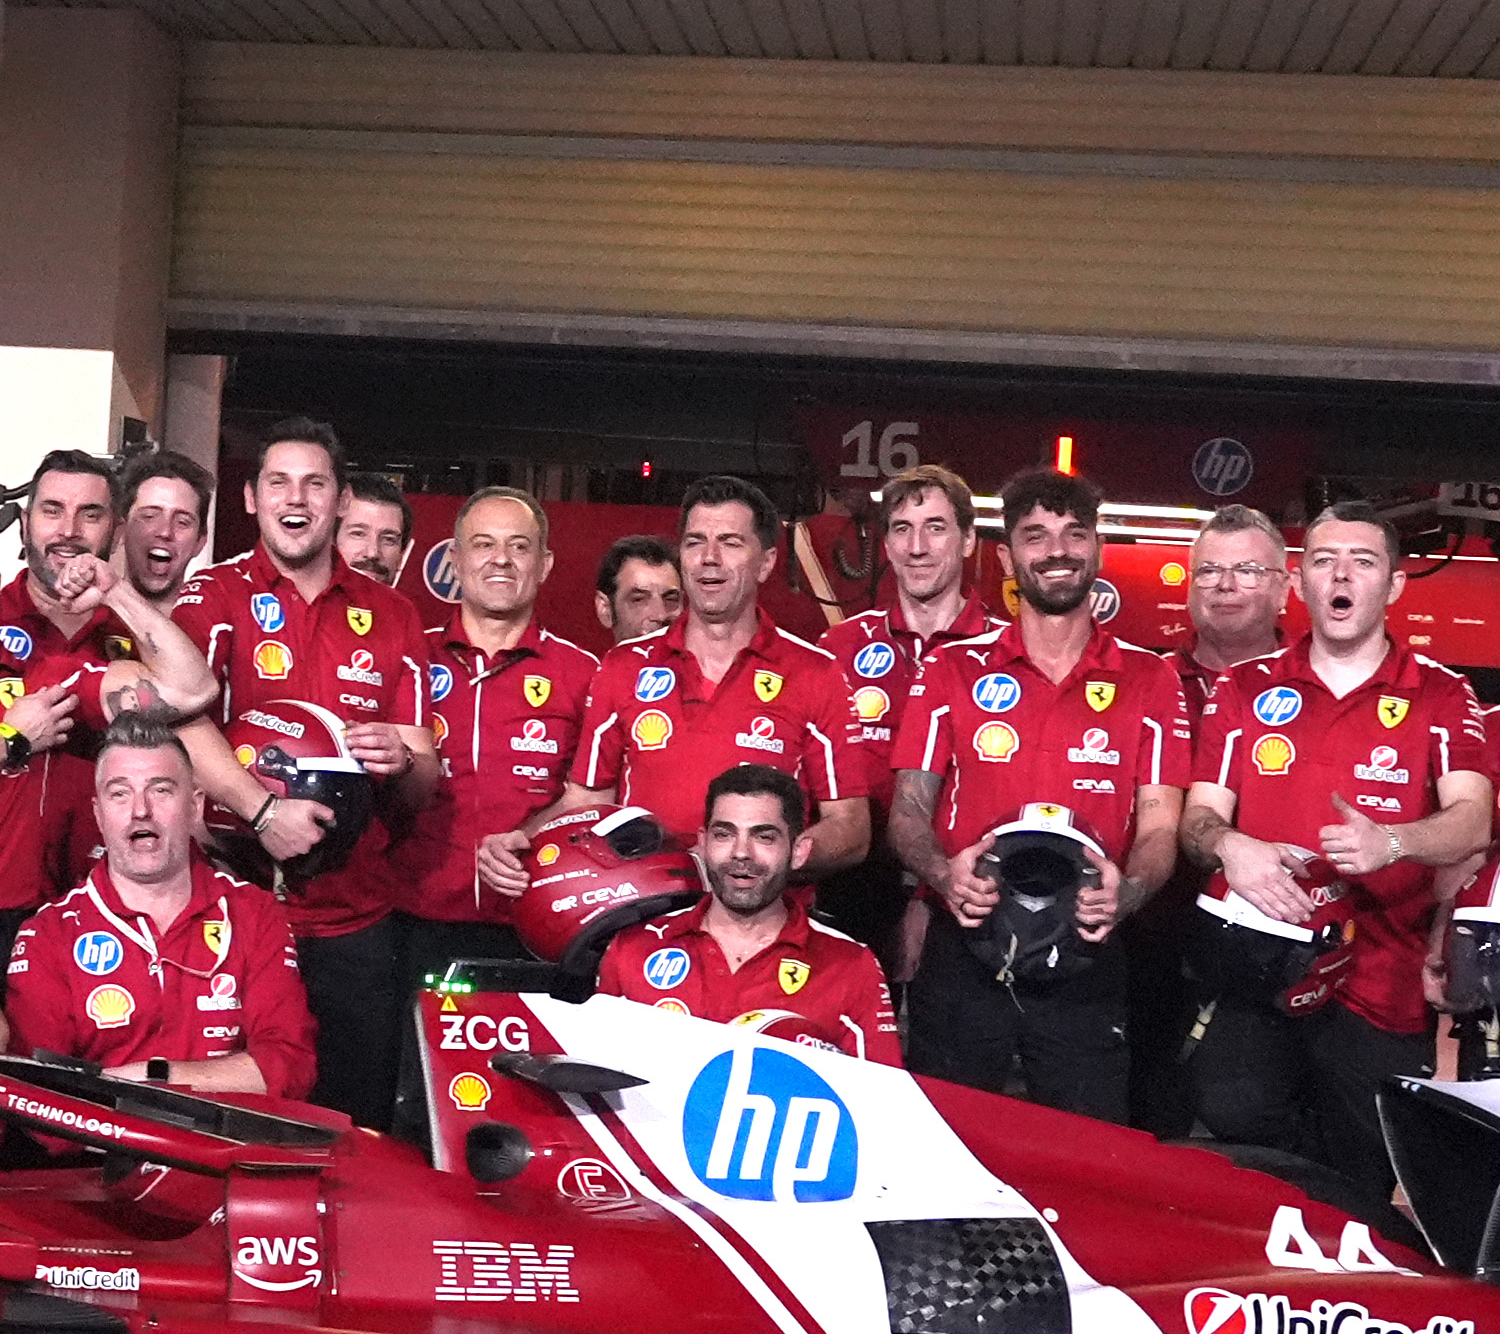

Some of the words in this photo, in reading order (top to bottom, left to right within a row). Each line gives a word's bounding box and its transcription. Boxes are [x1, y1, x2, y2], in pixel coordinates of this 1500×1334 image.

[841, 420, 922, 479] 16
[1199, 438, 1246, 495] hp
[254, 592, 283, 633] hp
[857, 642, 892, 678] hp
[340, 692, 379, 709] CEVA
[638, 667, 672, 703] hp
[976, 673, 1018, 713] hp
[1257, 686, 1300, 726] hp
[249, 710, 306, 740] UniCredit
[511, 736, 558, 755] UniCredit
[736, 733, 784, 754] UniCredit
[1068, 748, 1120, 765] UniCredit
[512, 765, 550, 777] CEVA
[1073, 779, 1116, 791] CEVA
[1354, 764, 1410, 784] UniCredit
[1357, 794, 1402, 810] CEVA
[581, 881, 638, 905] CEVA
[78, 931, 120, 975] hp
[647, 947, 687, 989] hp
[203, 1025, 240, 1039] CEVA
[7, 1092, 128, 1141] TECHNOLOGY
[700, 1047, 845, 1203] hp
[237, 1235, 320, 1268] aws
[51, 1266, 141, 1291] UniCredit
[432, 1240, 582, 1303] IBM
